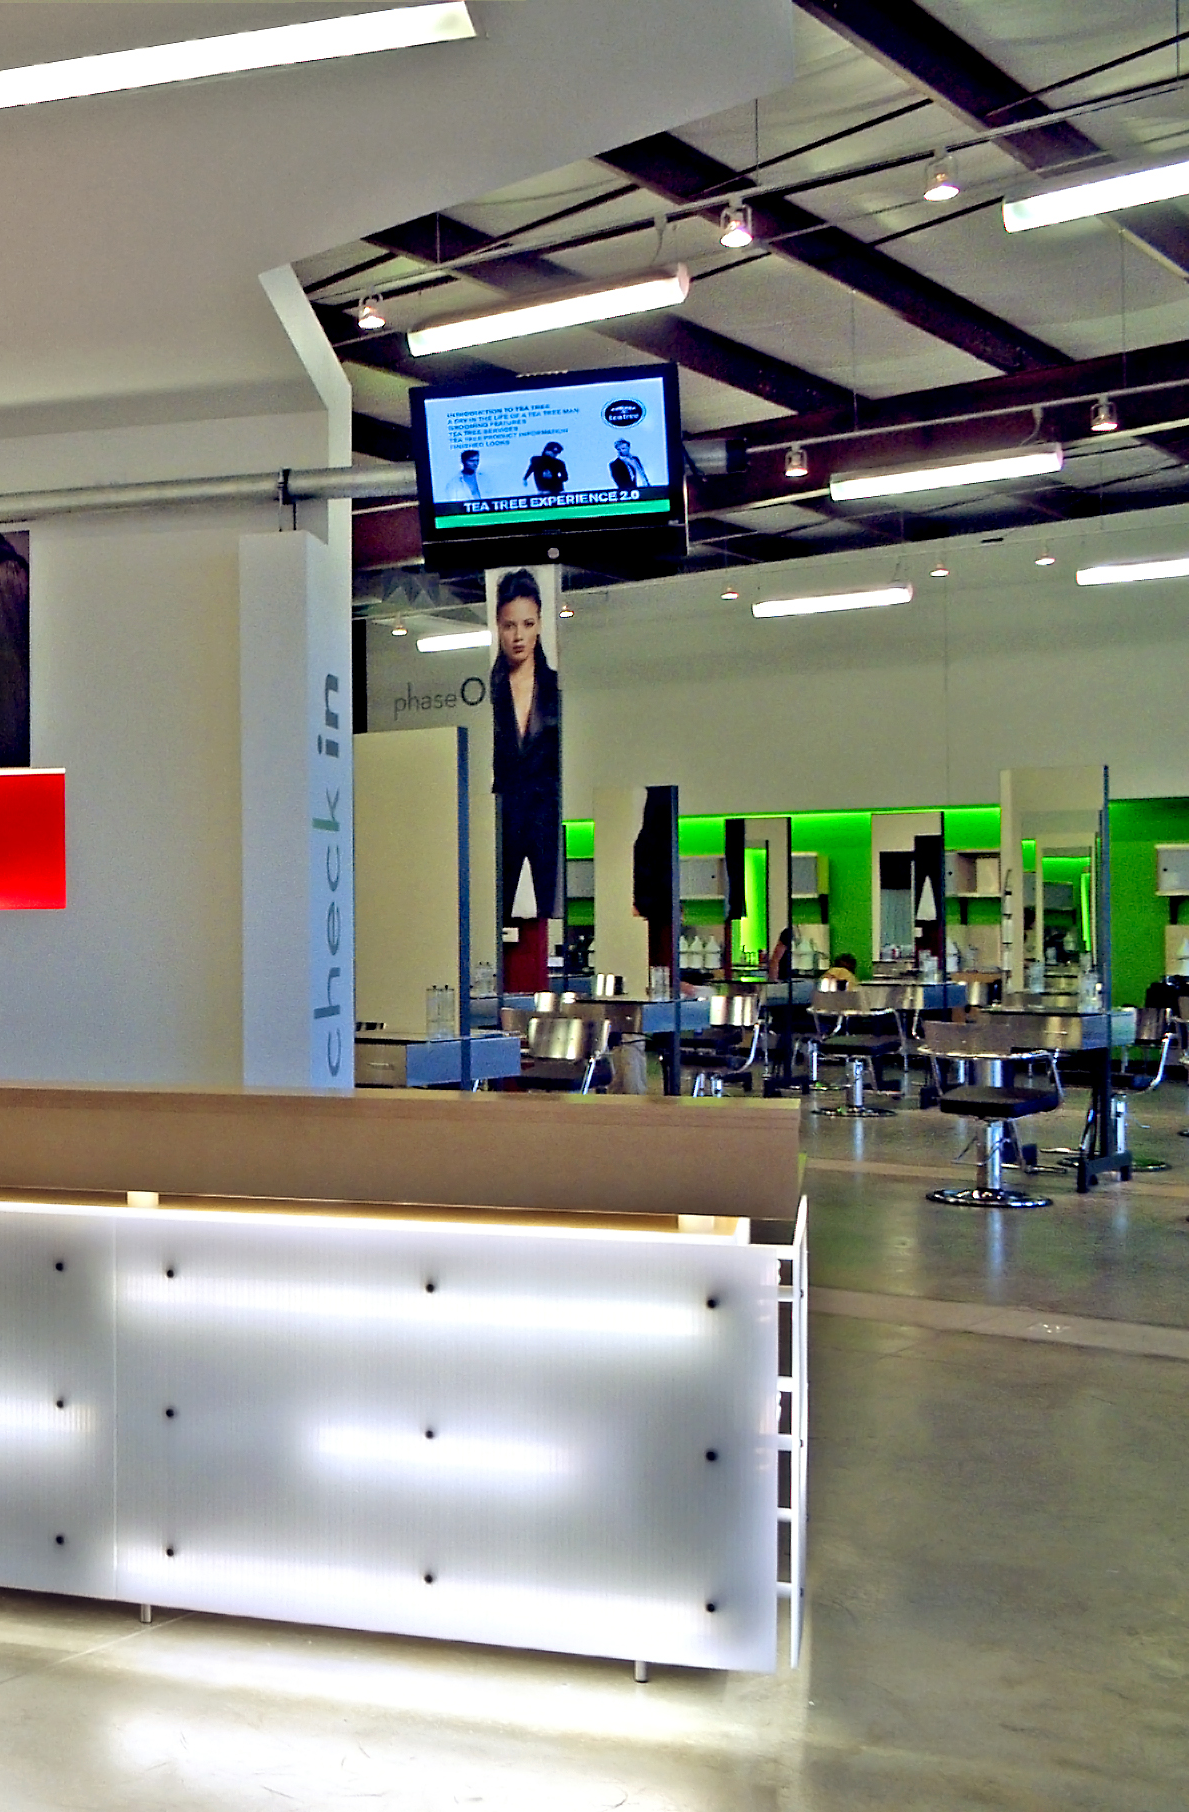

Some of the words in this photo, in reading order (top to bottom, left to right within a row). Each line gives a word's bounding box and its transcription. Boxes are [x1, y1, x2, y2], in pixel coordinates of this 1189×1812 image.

[464, 501, 490, 513] TEA
[492, 498, 528, 511] TREE
[530, 491, 617, 508] EXPERIENCE
[620, 489, 640, 501] 2.0
[318, 673, 340, 758] in
[393, 682, 457, 721] phase
[312, 787, 341, 1077] check
